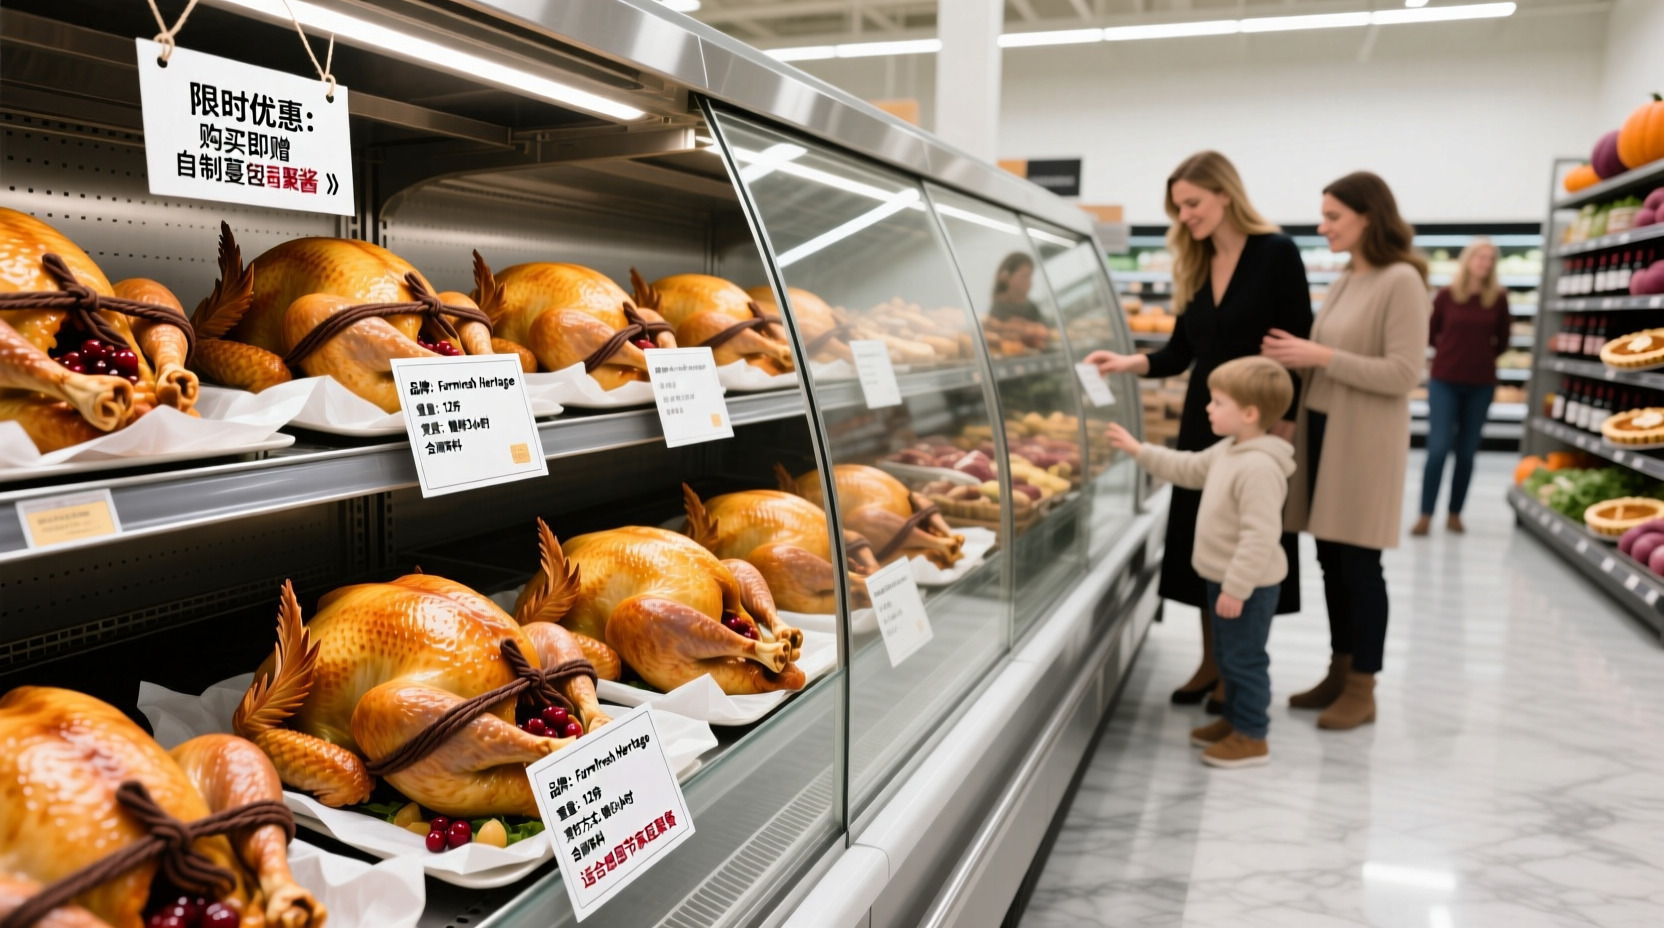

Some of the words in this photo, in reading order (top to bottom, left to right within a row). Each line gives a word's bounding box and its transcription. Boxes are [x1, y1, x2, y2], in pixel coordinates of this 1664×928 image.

[189, 81, 314, 132] 限时优惠：
[199, 123, 291, 162] 购买即赠
